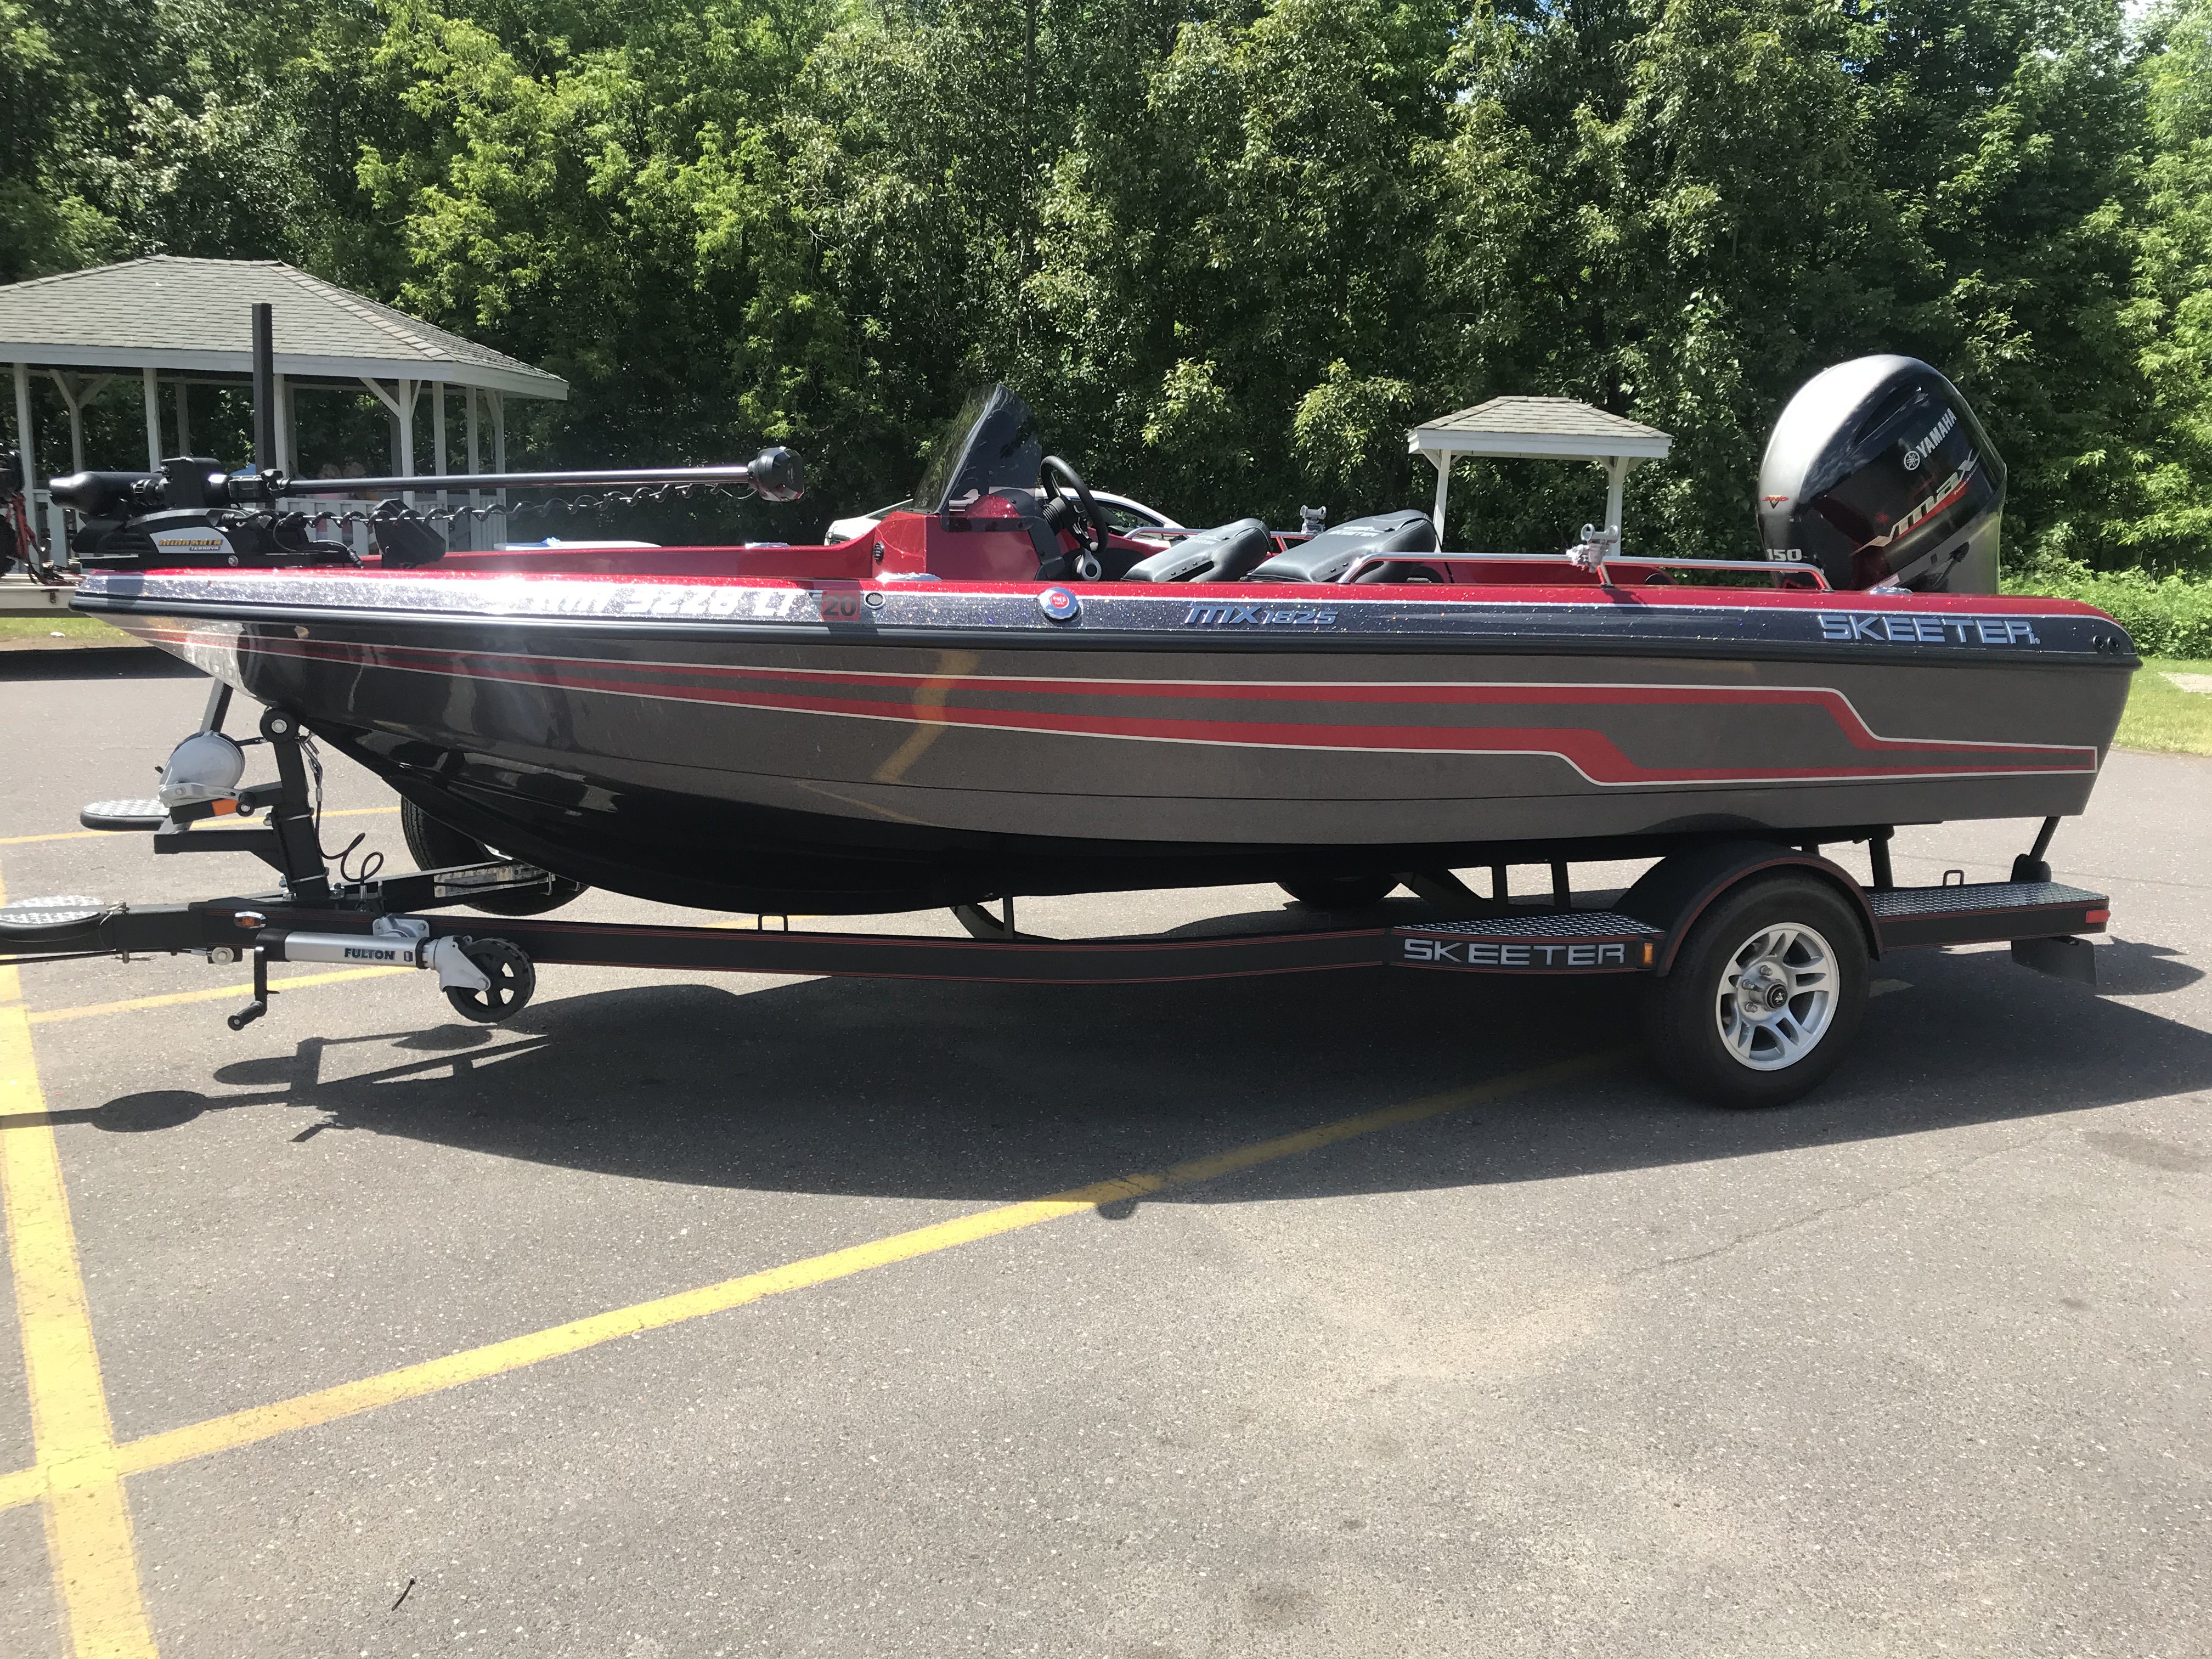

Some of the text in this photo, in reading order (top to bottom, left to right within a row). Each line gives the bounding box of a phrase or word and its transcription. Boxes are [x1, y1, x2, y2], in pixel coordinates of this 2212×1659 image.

[1915, 408, 1957, 458] YAMAHA
[1767, 549, 1802, 561] 150
[751, 588, 807, 617] LT
[823, 596, 857, 617] 20
[1818, 614, 2036, 645] SKEETER
[344, 948, 396, 961] FULTON
[1404, 938, 1626, 966] SKEETER
